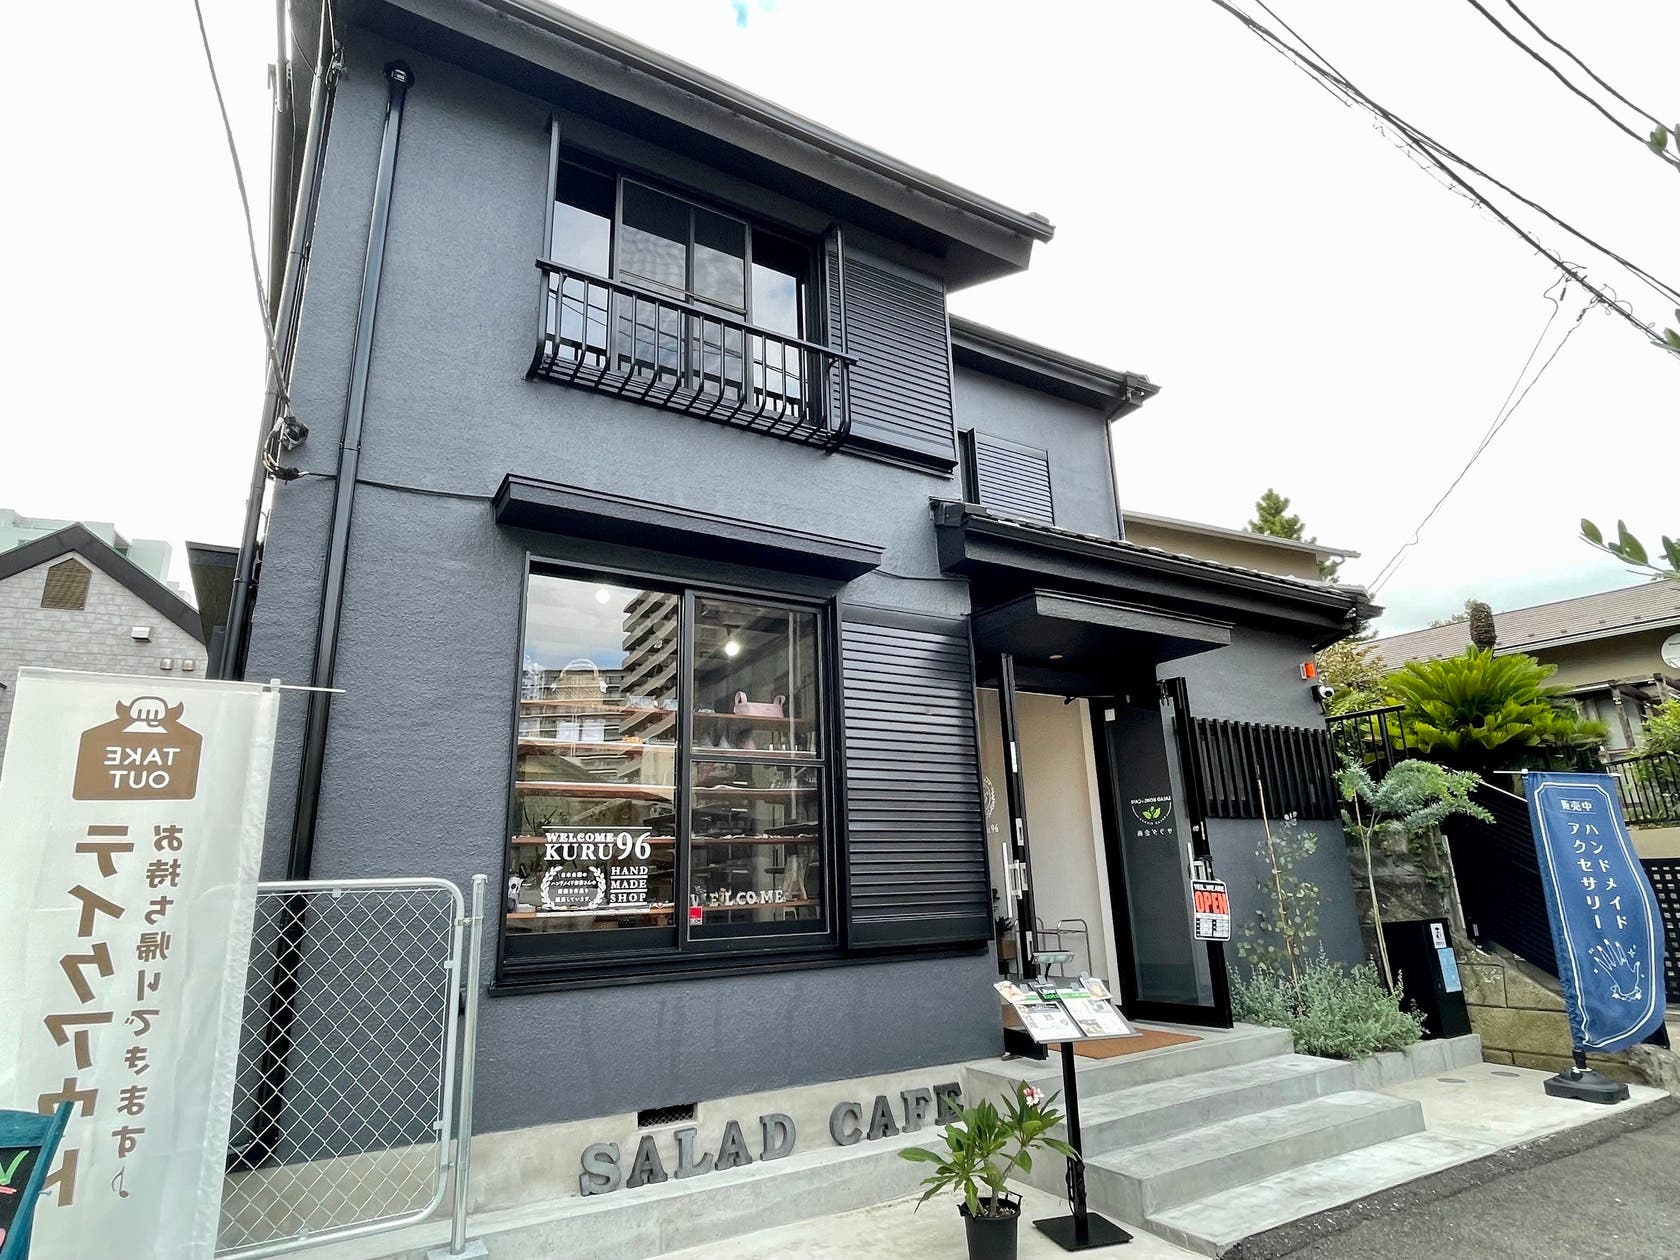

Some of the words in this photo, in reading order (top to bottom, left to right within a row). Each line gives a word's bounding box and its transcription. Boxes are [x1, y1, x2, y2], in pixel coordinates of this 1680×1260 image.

[544, 843, 614, 860] KURU
[617, 832, 652, 860] 96
[545, 832, 615, 843] WELCOME
[611, 866, 648, 875] HAND
[1567, 822, 1602, 930] アクセサリー
[1585, 824, 1628, 930] ハンドメイド
[610, 880, 647, 889] MADE
[610, 893, 647, 902] SHOP
[1195, 891, 1228, 914] OPEN
[579, 1112, 796, 1196] SALAD
[829, 1082, 965, 1146] CAFE
